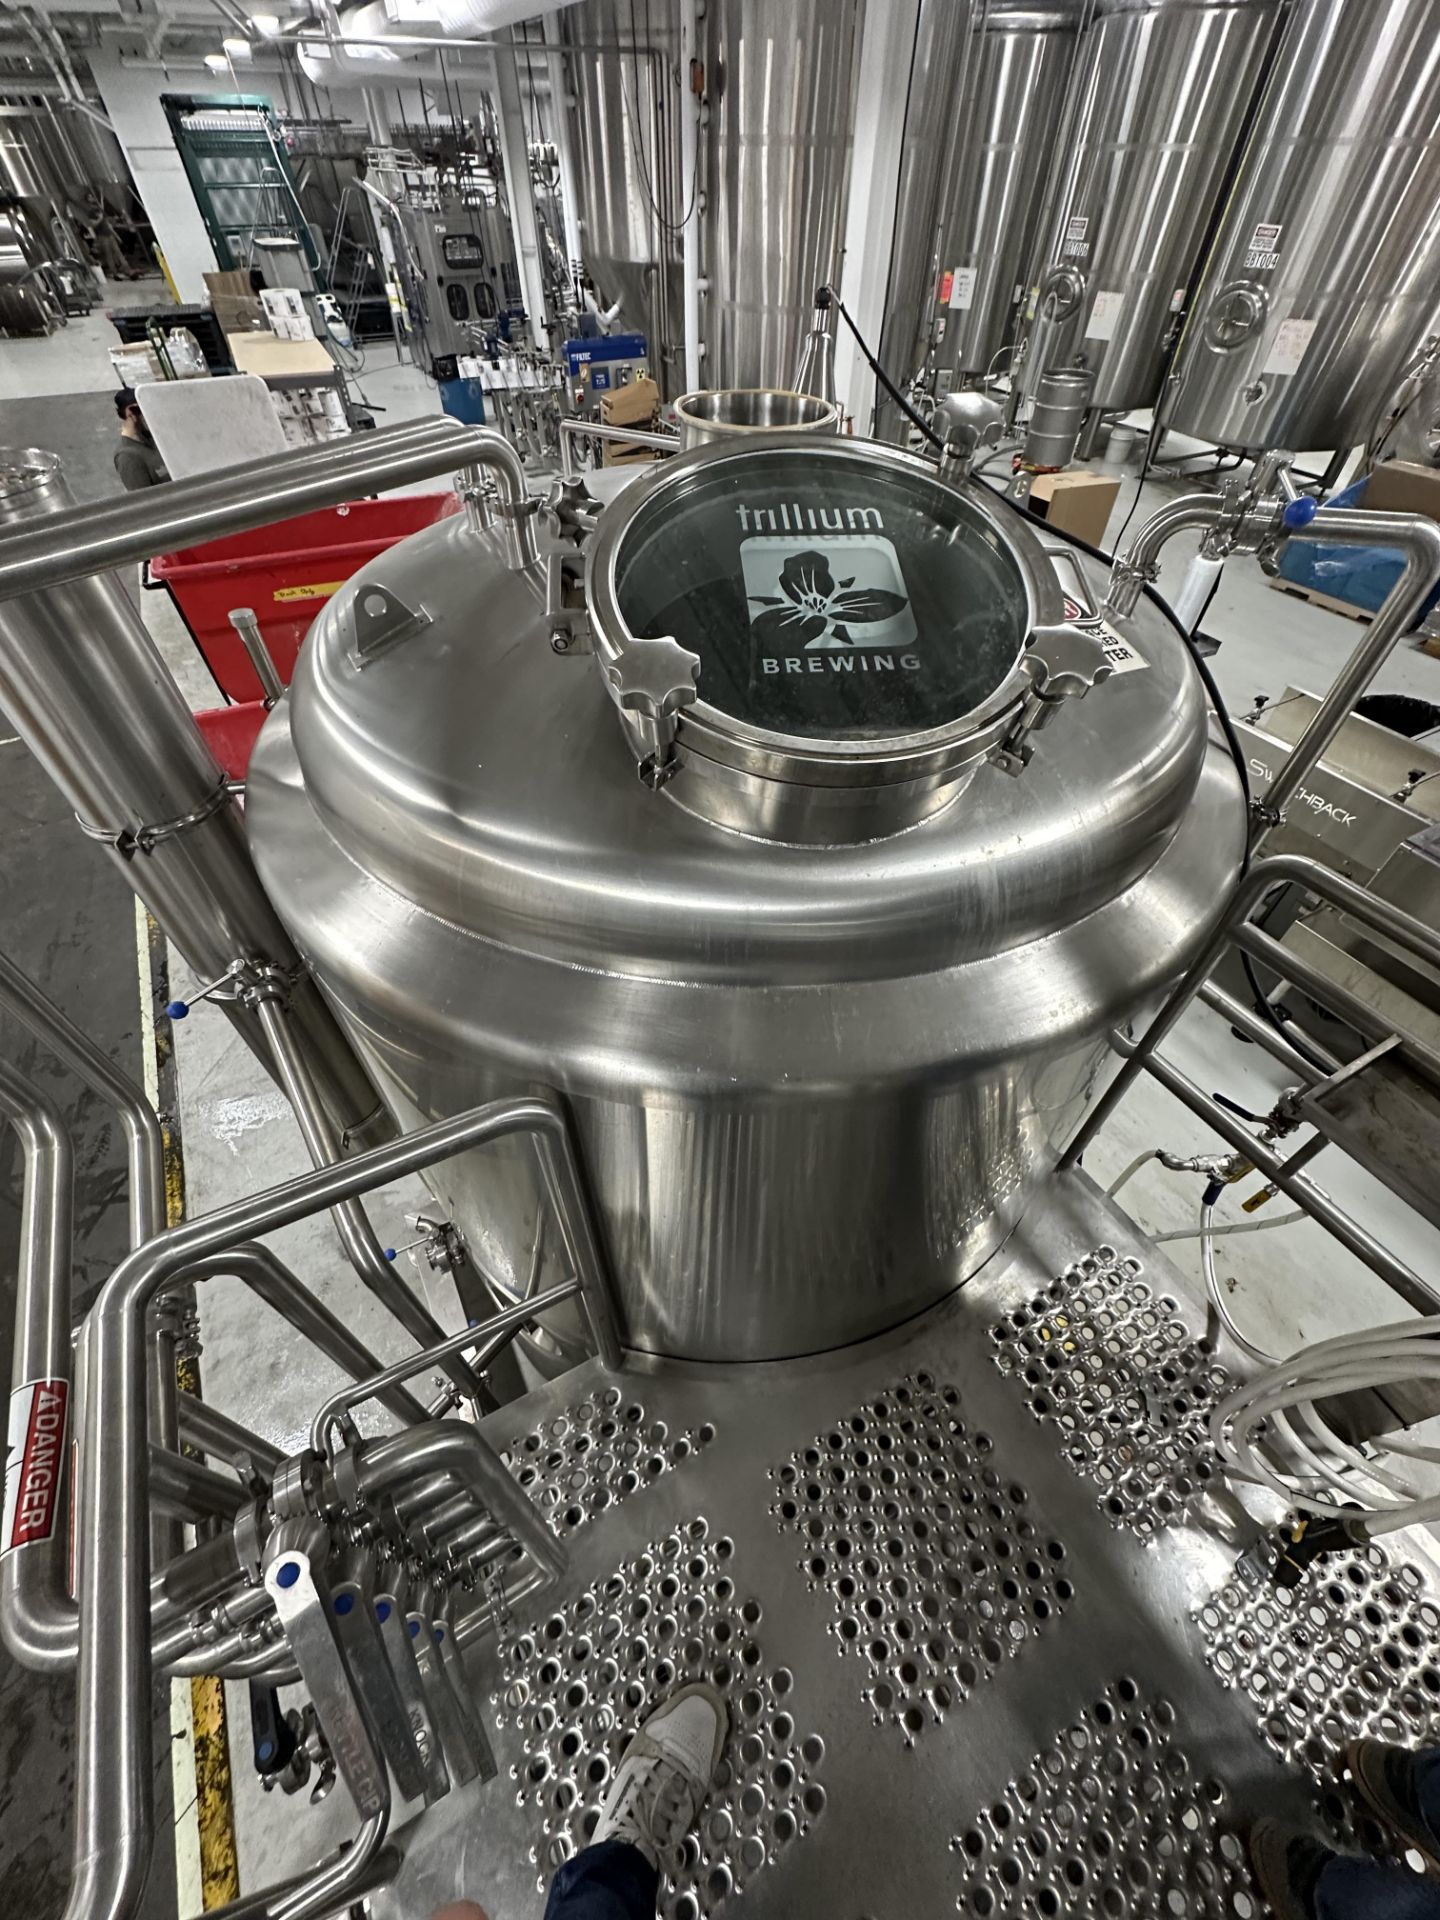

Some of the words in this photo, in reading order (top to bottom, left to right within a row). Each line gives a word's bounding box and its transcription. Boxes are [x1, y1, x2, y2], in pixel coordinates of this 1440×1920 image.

[1244, 252, 1279, 268] BBT004
[736, 503, 884, 530] trillium
[762, 654, 921, 674] BREWING
[1105, 647, 1133, 662] TER
[19, 1416, 60, 1533] DANGER
